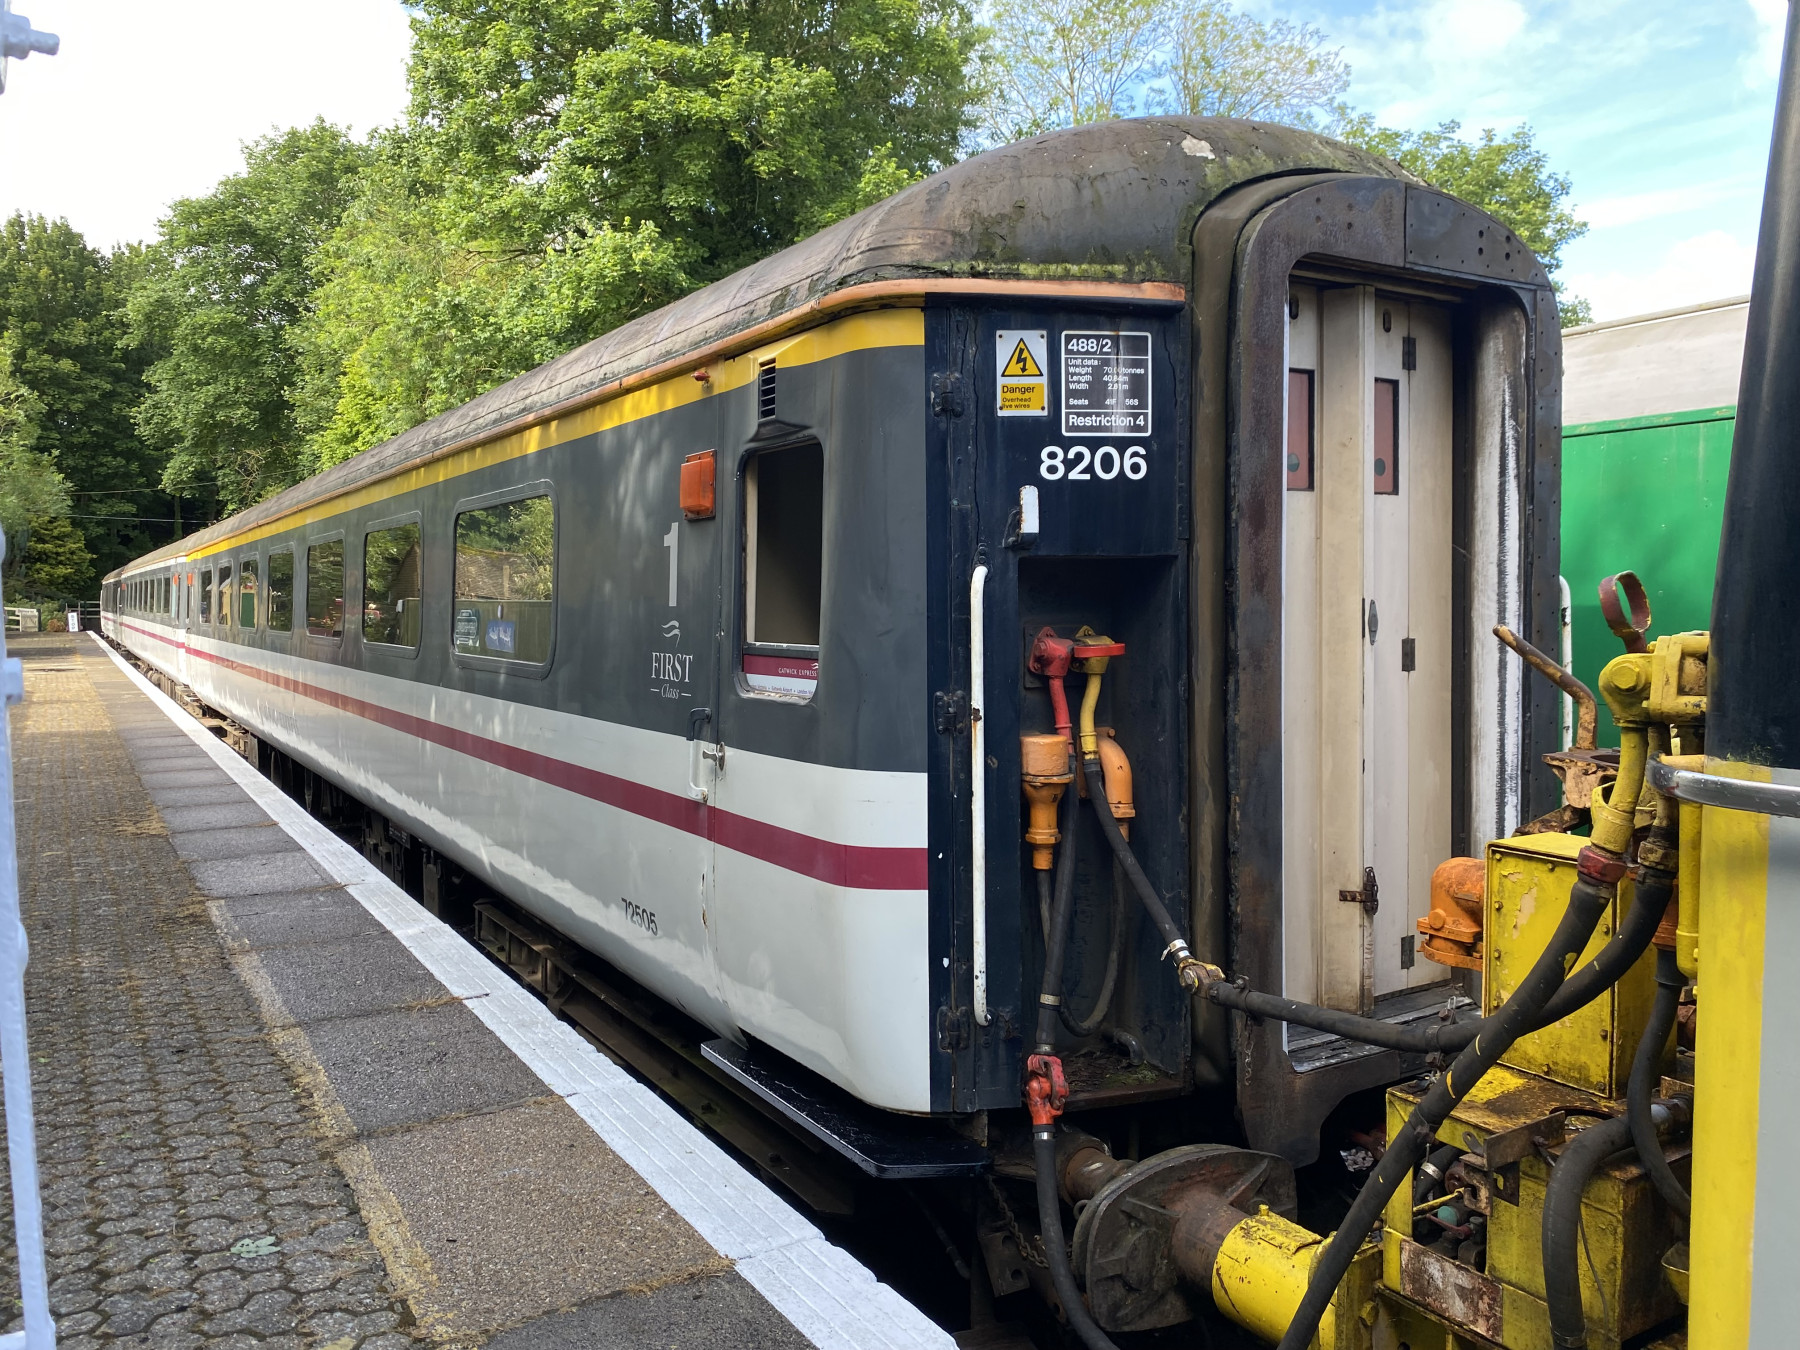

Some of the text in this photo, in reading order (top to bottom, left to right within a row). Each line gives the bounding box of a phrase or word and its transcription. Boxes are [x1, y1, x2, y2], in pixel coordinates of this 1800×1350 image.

[1067, 338, 1112, 355] 488/2
[1068, 358, 1082, 366] Unit
[1068, 366, 1092, 375] Weight
[1068, 374, 1093, 383] Length
[1002, 385, 1036, 395] Danger
[1068, 382, 1089, 390] Width
[1068, 398, 1089, 406] Seats
[1068, 414, 1145, 427] Restriction 4
[1039, 445, 1148, 481] 8206
[663, 521, 679, 607] 1
[650, 651, 694, 683] FIRST
[778, 667, 818, 677] GATWICK EXPRESS
[661, 683, 680, 700] Class
[621, 896, 659, 937] 72505
